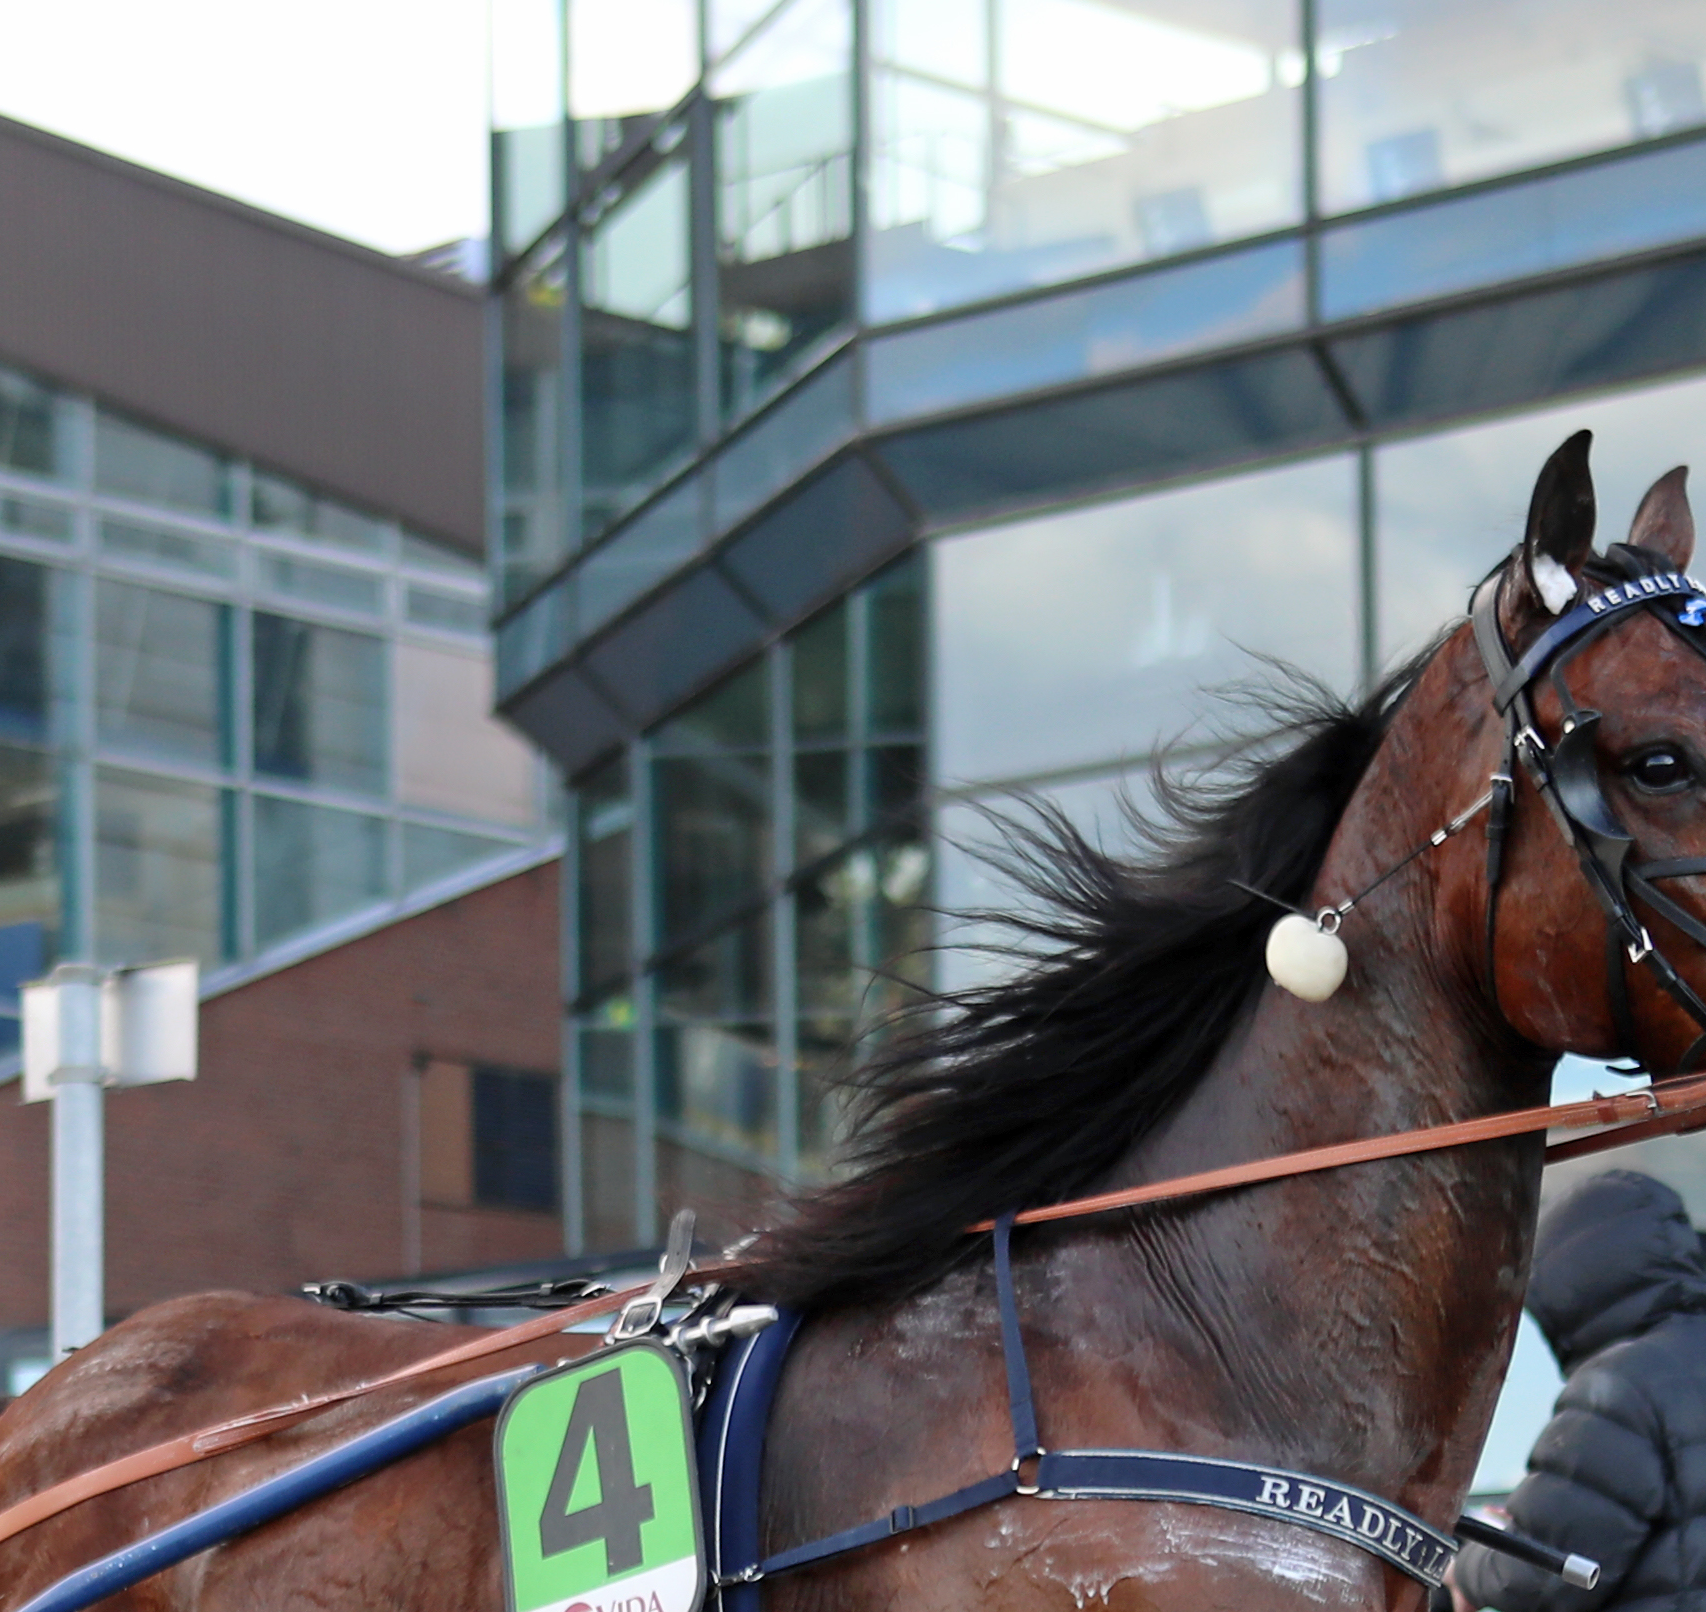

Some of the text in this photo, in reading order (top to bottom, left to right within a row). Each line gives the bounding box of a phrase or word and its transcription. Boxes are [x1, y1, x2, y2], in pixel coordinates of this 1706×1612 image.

[1587, 574, 1681, 613] READLY
[538, 1366, 655, 1577] 4
[1255, 1476, 1424, 1561] READLY
